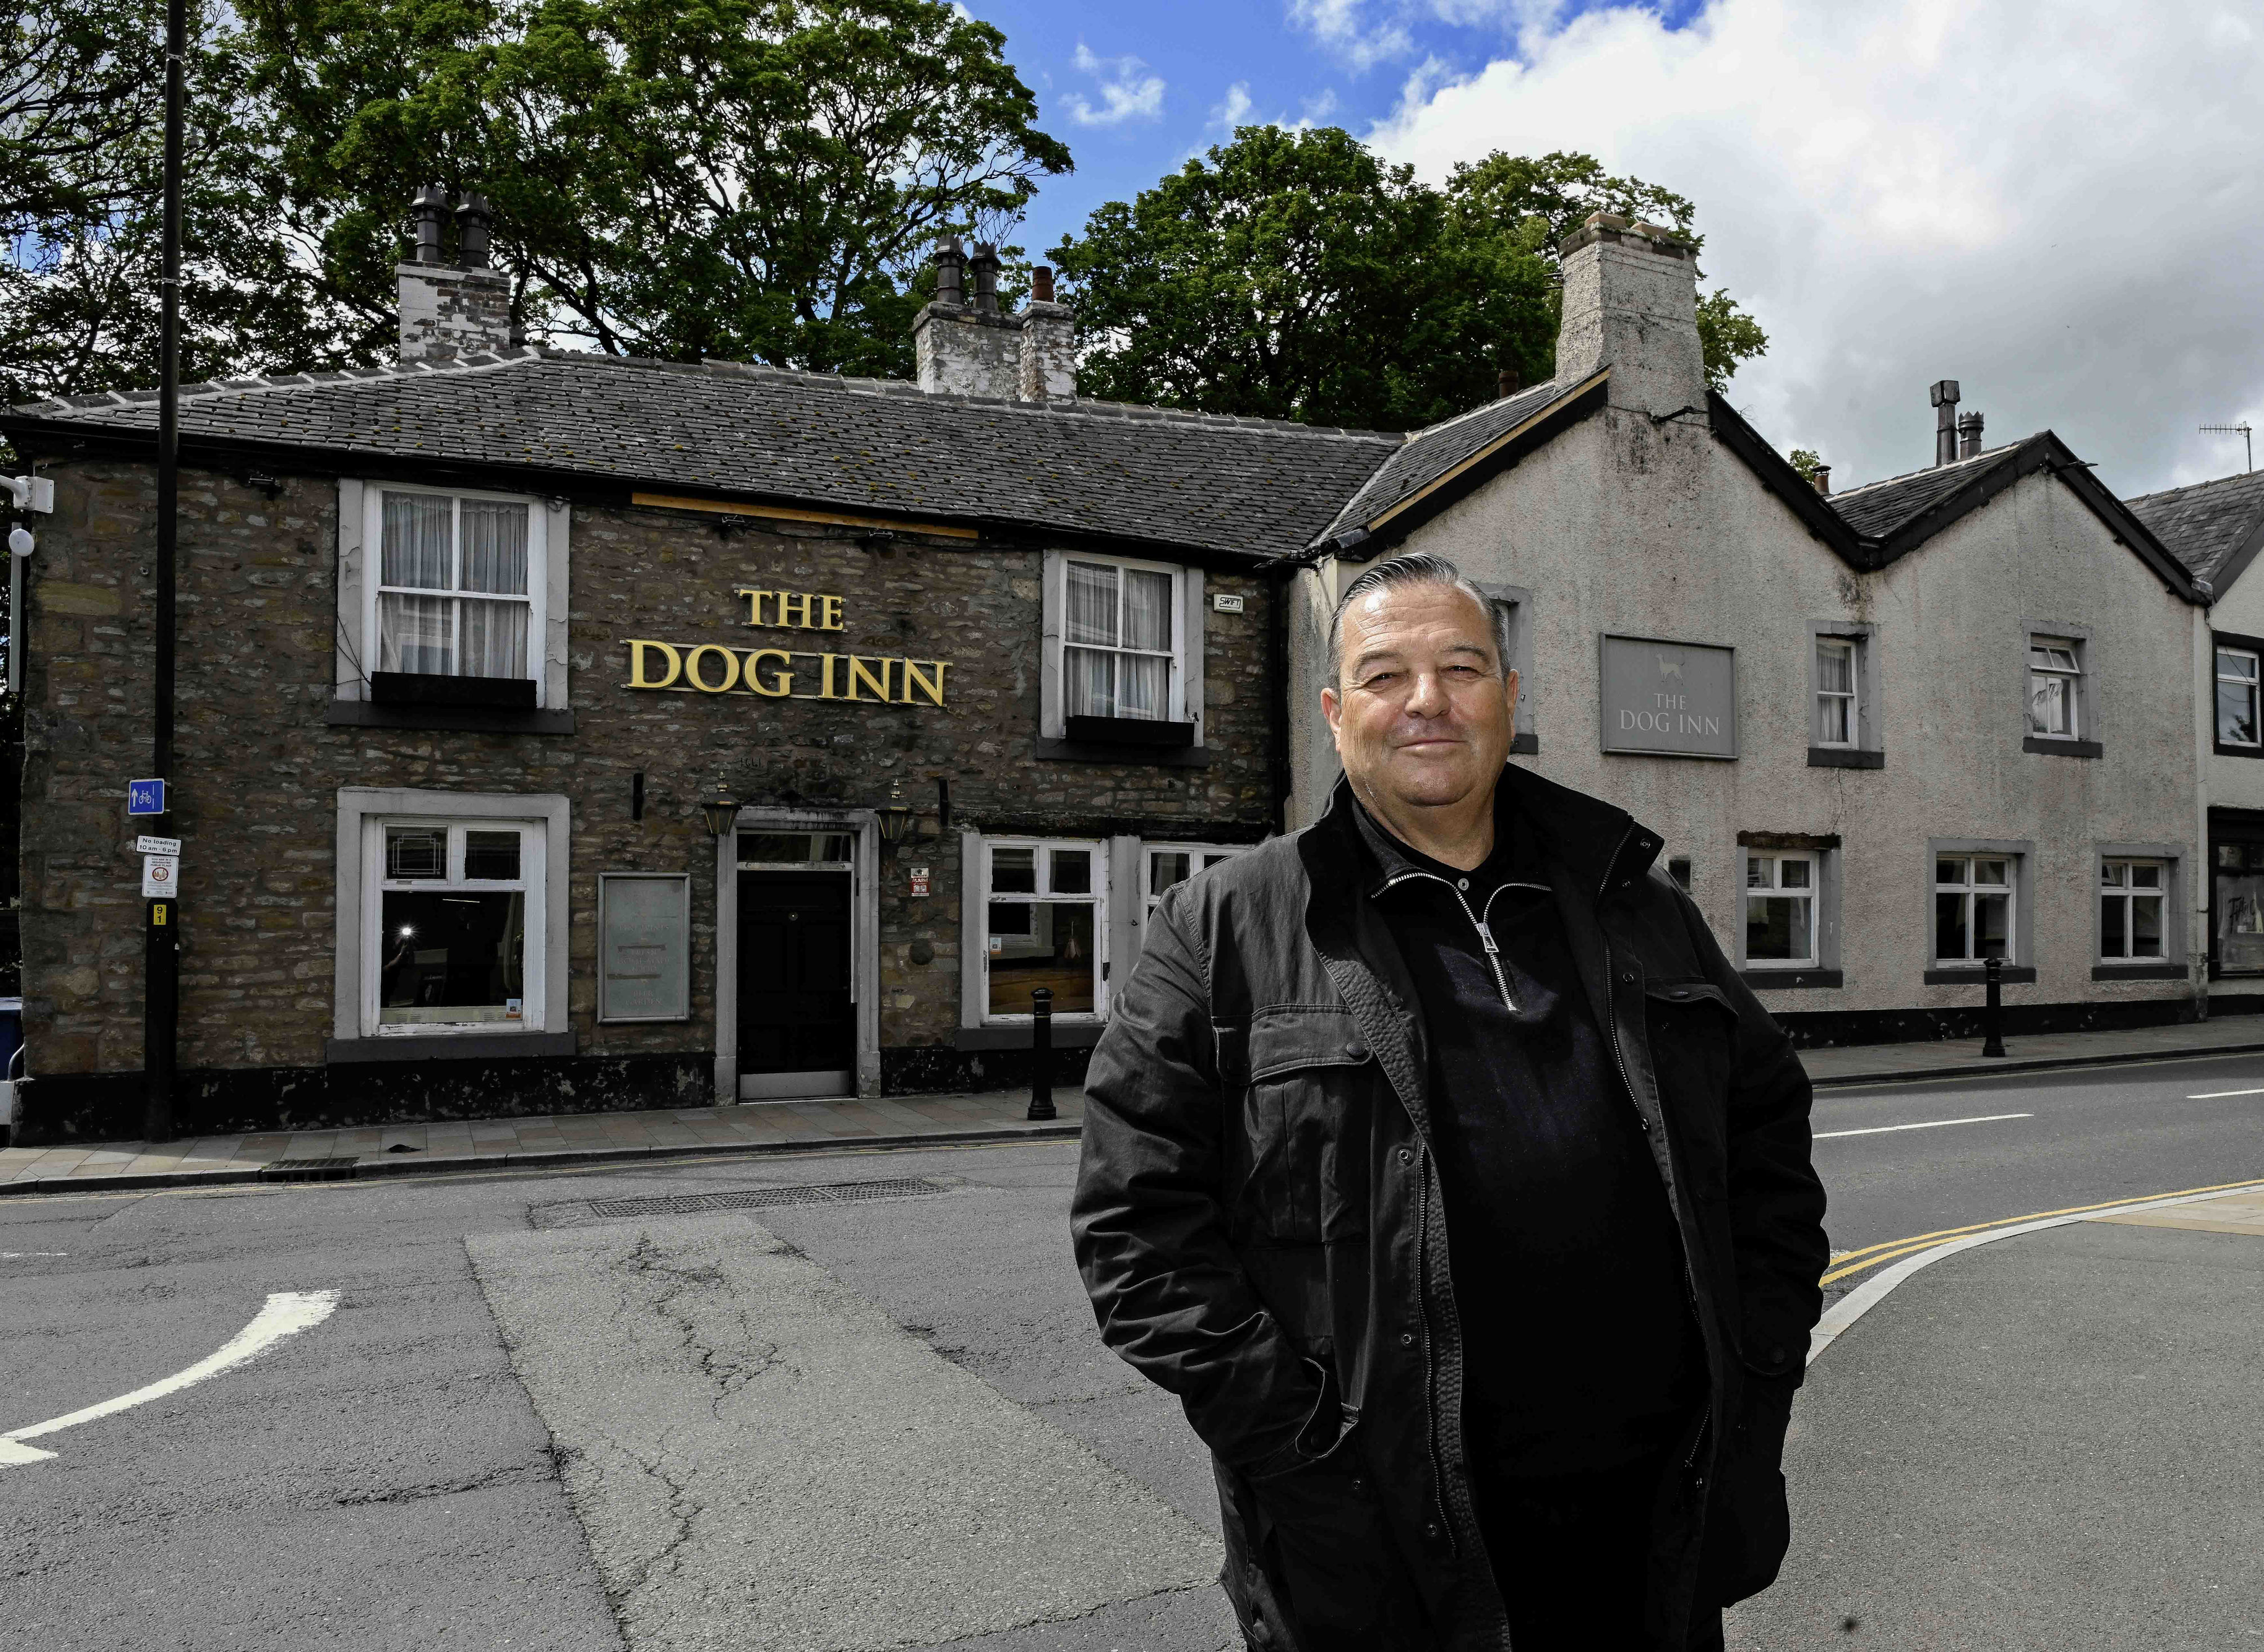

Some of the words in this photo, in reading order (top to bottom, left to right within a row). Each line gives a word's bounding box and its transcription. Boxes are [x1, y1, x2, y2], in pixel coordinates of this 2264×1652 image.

[738, 588, 843, 631] THE
[1220, 597, 1240, 608] SWIFT
[625, 639, 795, 698] DOG
[816, 652, 949, 707] INN
[1654, 693, 1686, 710] THE
[1620, 709, 1670, 733] DOG
[1679, 714, 1720, 735] INN
